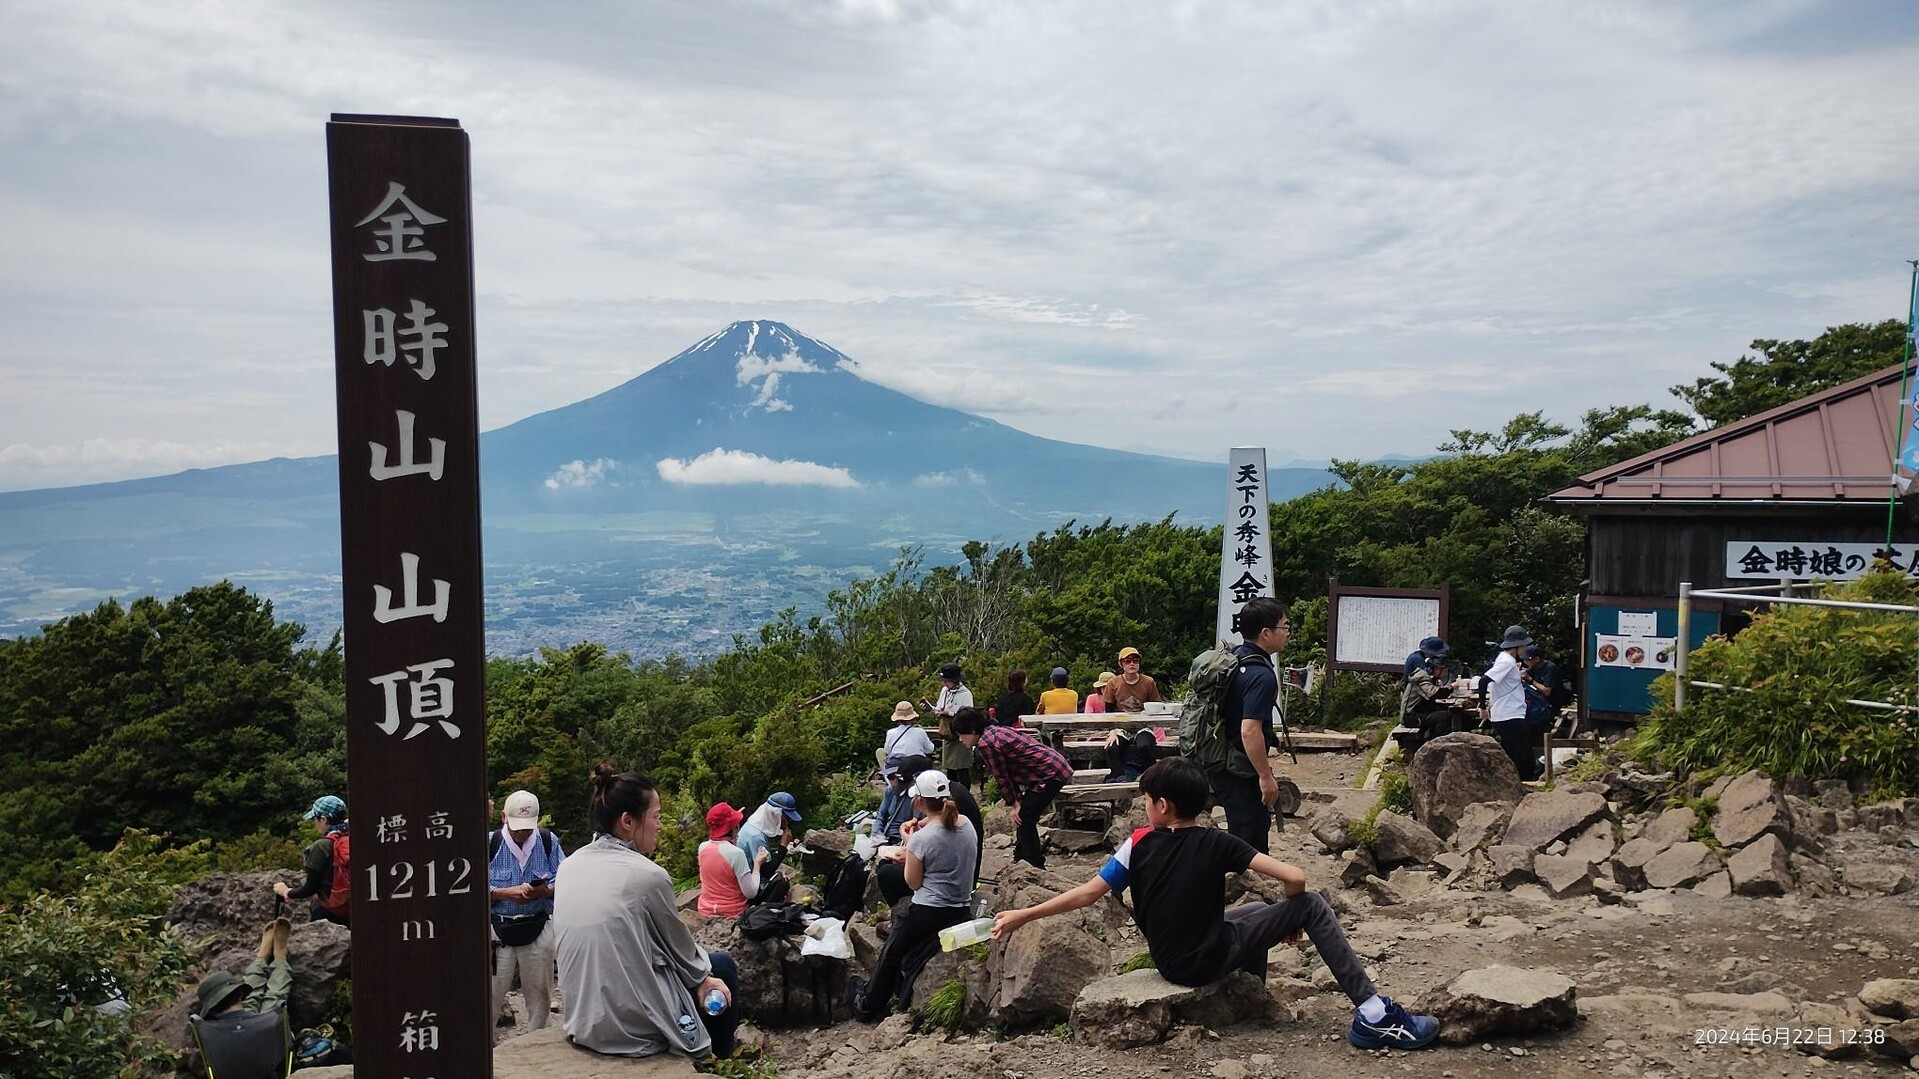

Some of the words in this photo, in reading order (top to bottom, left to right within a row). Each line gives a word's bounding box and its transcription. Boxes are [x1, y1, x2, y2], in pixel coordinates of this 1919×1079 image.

[376, 811, 453, 844] 標高
[366, 857, 472, 902] 1212
[402, 920, 435, 941] m
[399, 1010, 439, 1079] 箱
